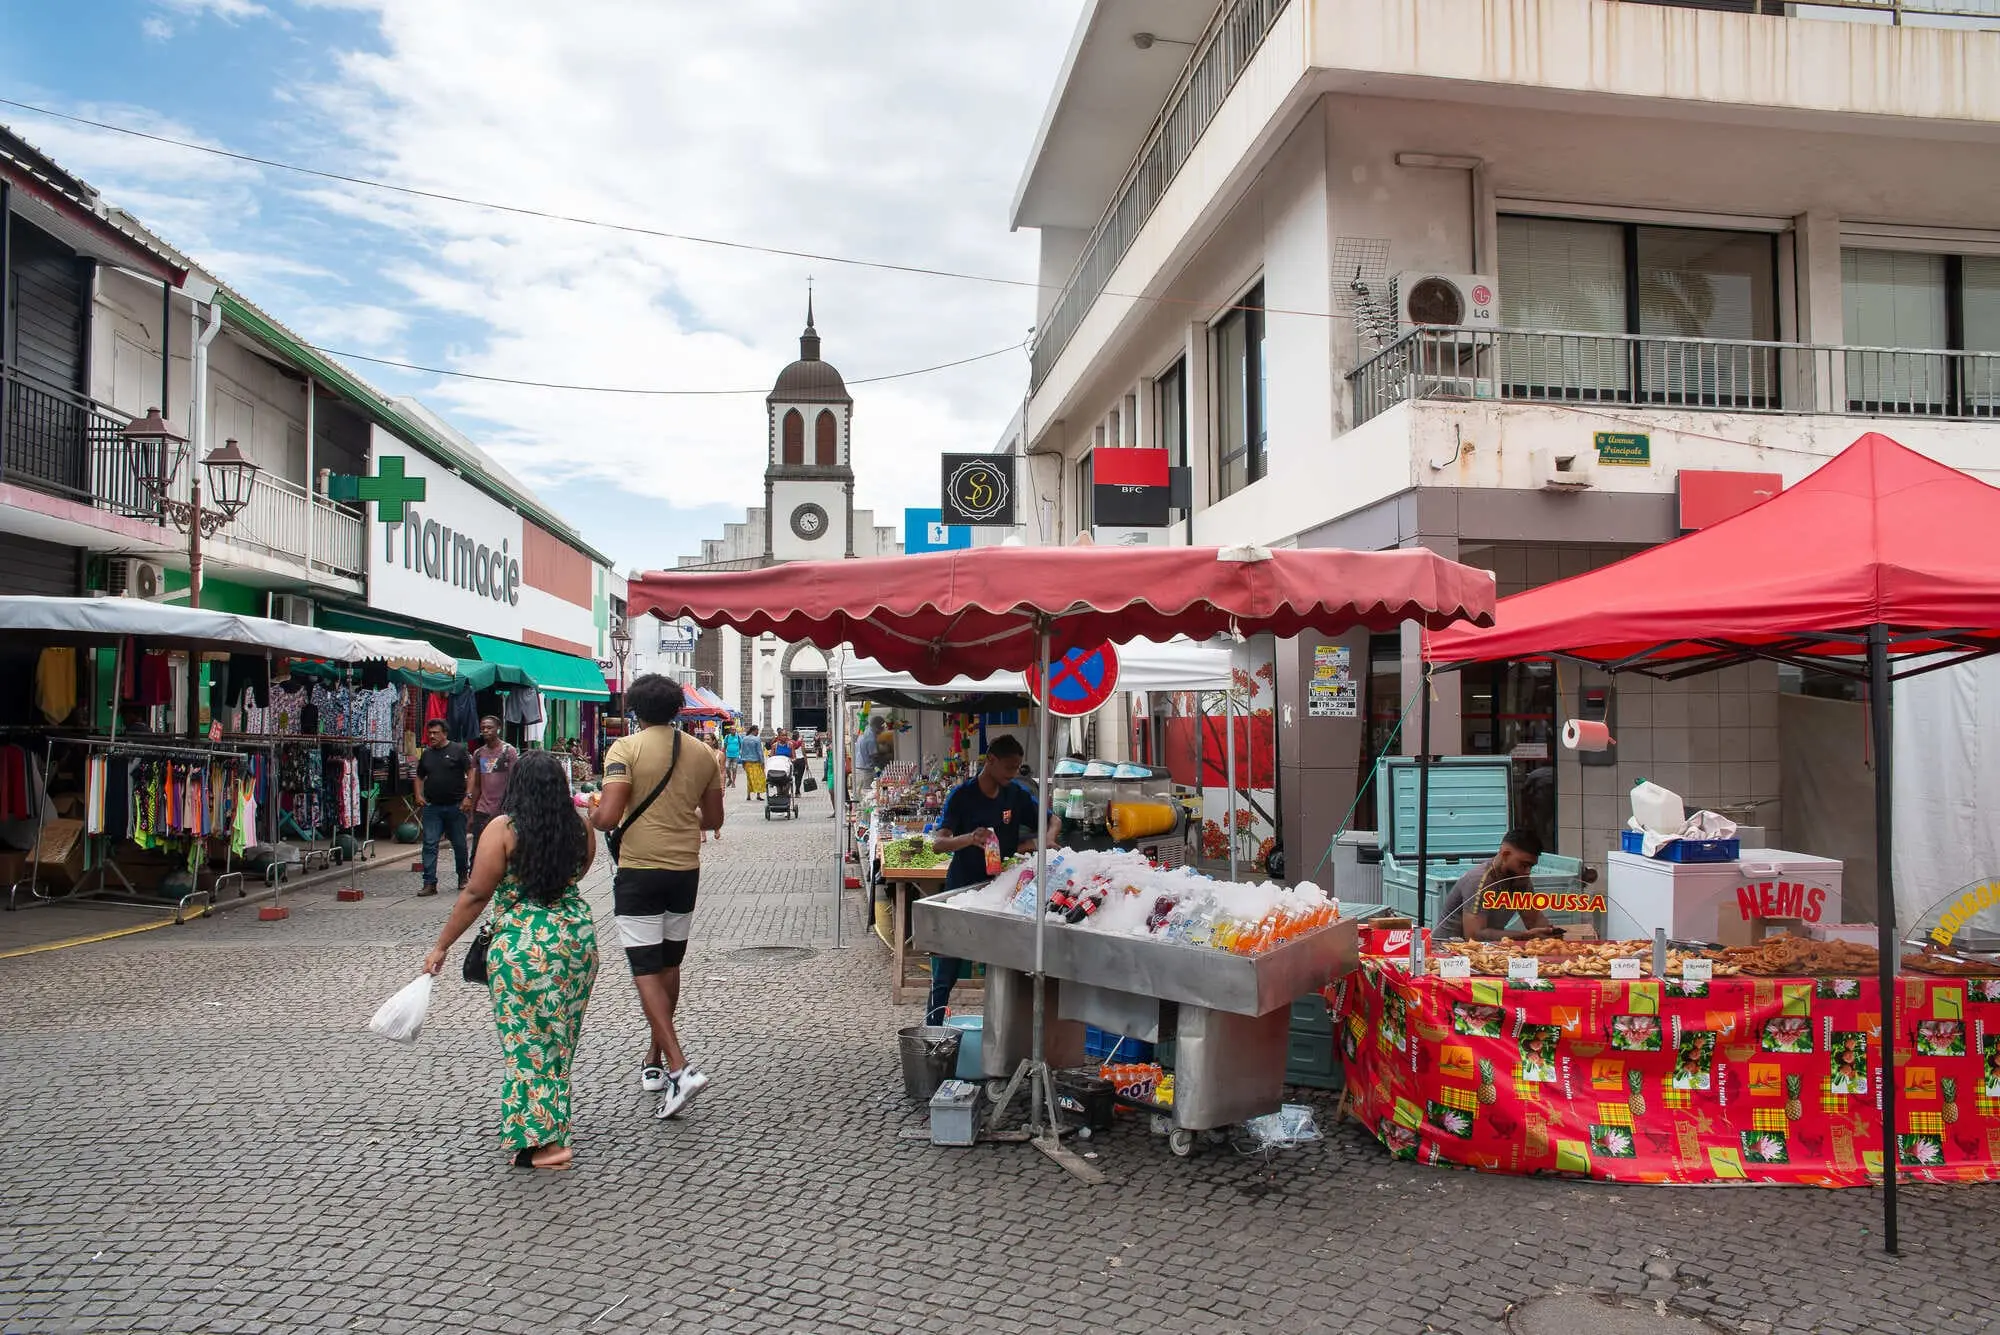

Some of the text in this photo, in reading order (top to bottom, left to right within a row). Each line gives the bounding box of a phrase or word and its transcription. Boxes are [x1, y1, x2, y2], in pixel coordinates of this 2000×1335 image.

[1473, 309, 1490, 319] LG
[1608, 435, 1636, 445] Avenue
[1603, 445, 1643, 456] Principale
[1121, 486, 1144, 494] BFC
[1482, 890, 1608, 913] SAMOUSSA
[1736, 881, 1827, 923] NEMS
[1388, 929, 1412, 943] NIKE
